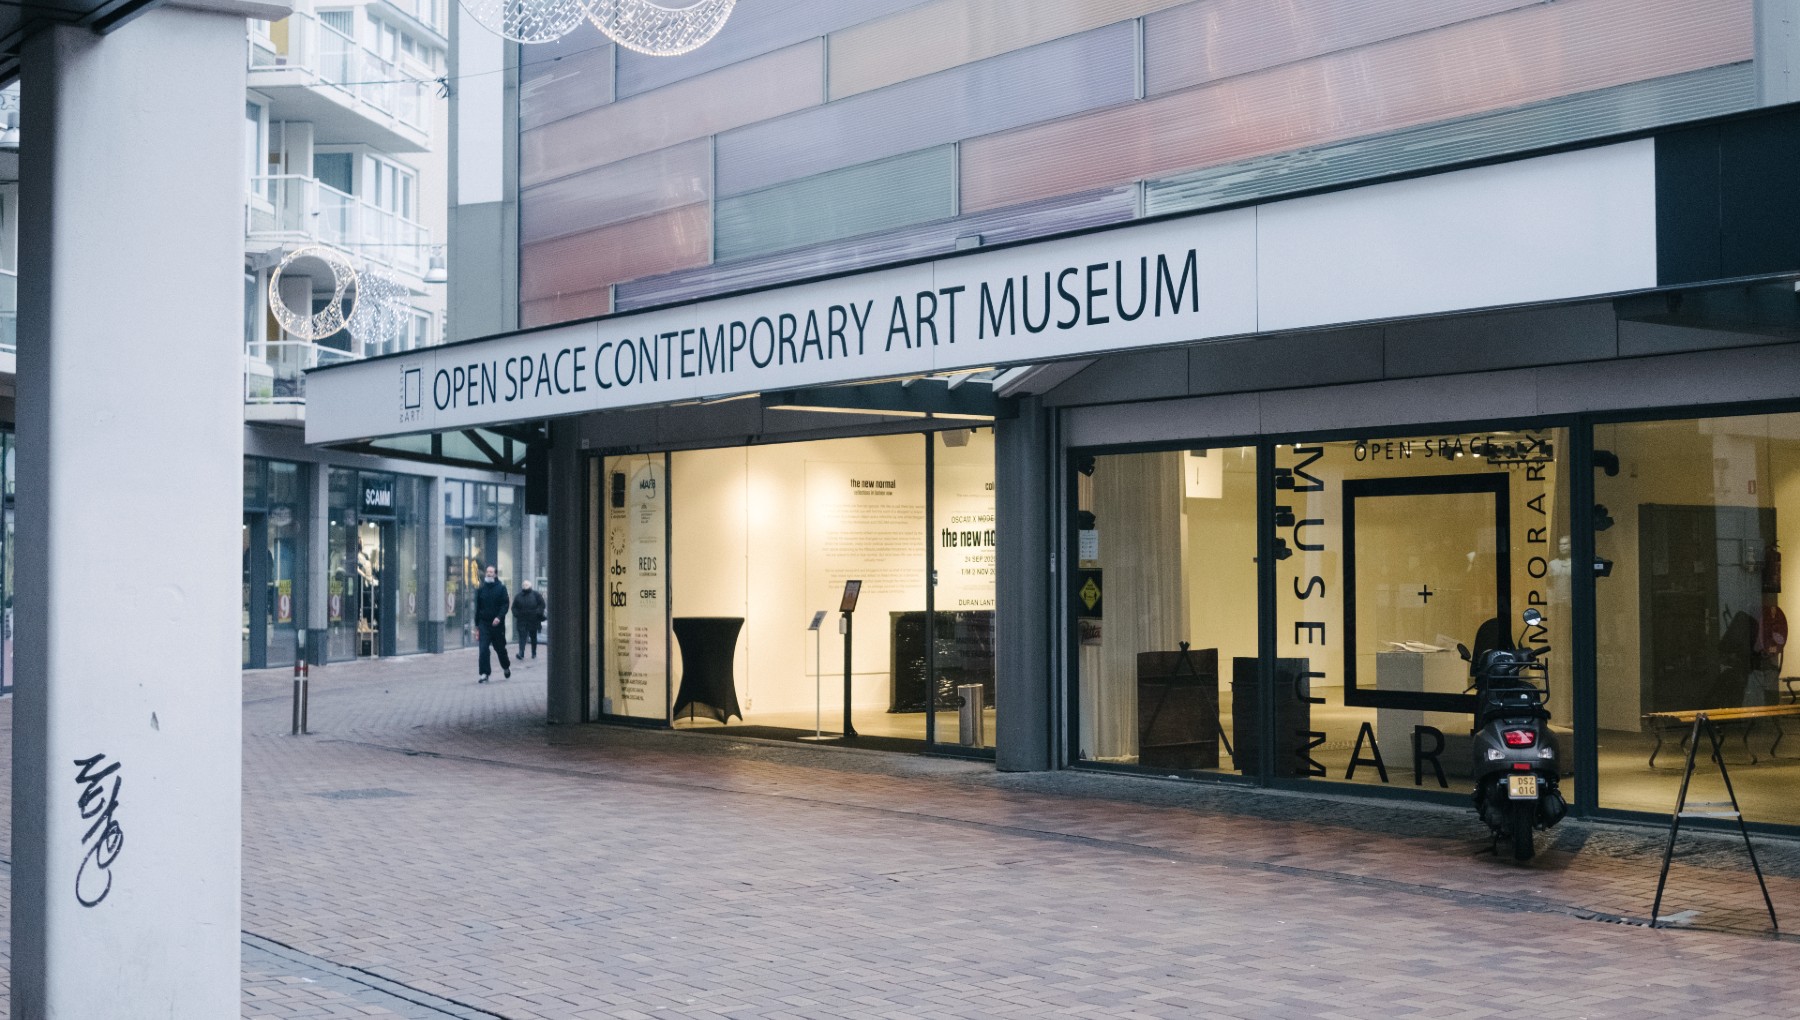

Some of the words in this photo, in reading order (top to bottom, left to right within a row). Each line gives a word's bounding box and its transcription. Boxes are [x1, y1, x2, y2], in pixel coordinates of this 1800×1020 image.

[434, 360, 497, 411] OPEN
[505, 346, 587, 402] SPACE
[595, 300, 873, 390] CONTEMPORARY
[885, 285, 966, 352] ART
[979, 248, 1199, 340] MUSEUM
[1354, 441, 1412, 462] OPEN
[1424, 436, 1495, 460] SPACE
[850, 479, 860, 488] the
[862, 480, 875, 488] new
[876, 479, 896, 489] normal
[942, 528, 958, 548] the
[960, 530, 982, 547] new
[984, 555, 995, 563] 202
[958, 599, 979, 607] DURAN
[1293, 446, 1327, 777] MUSEUM
[1517, 777, 1535, 785] DSZ
